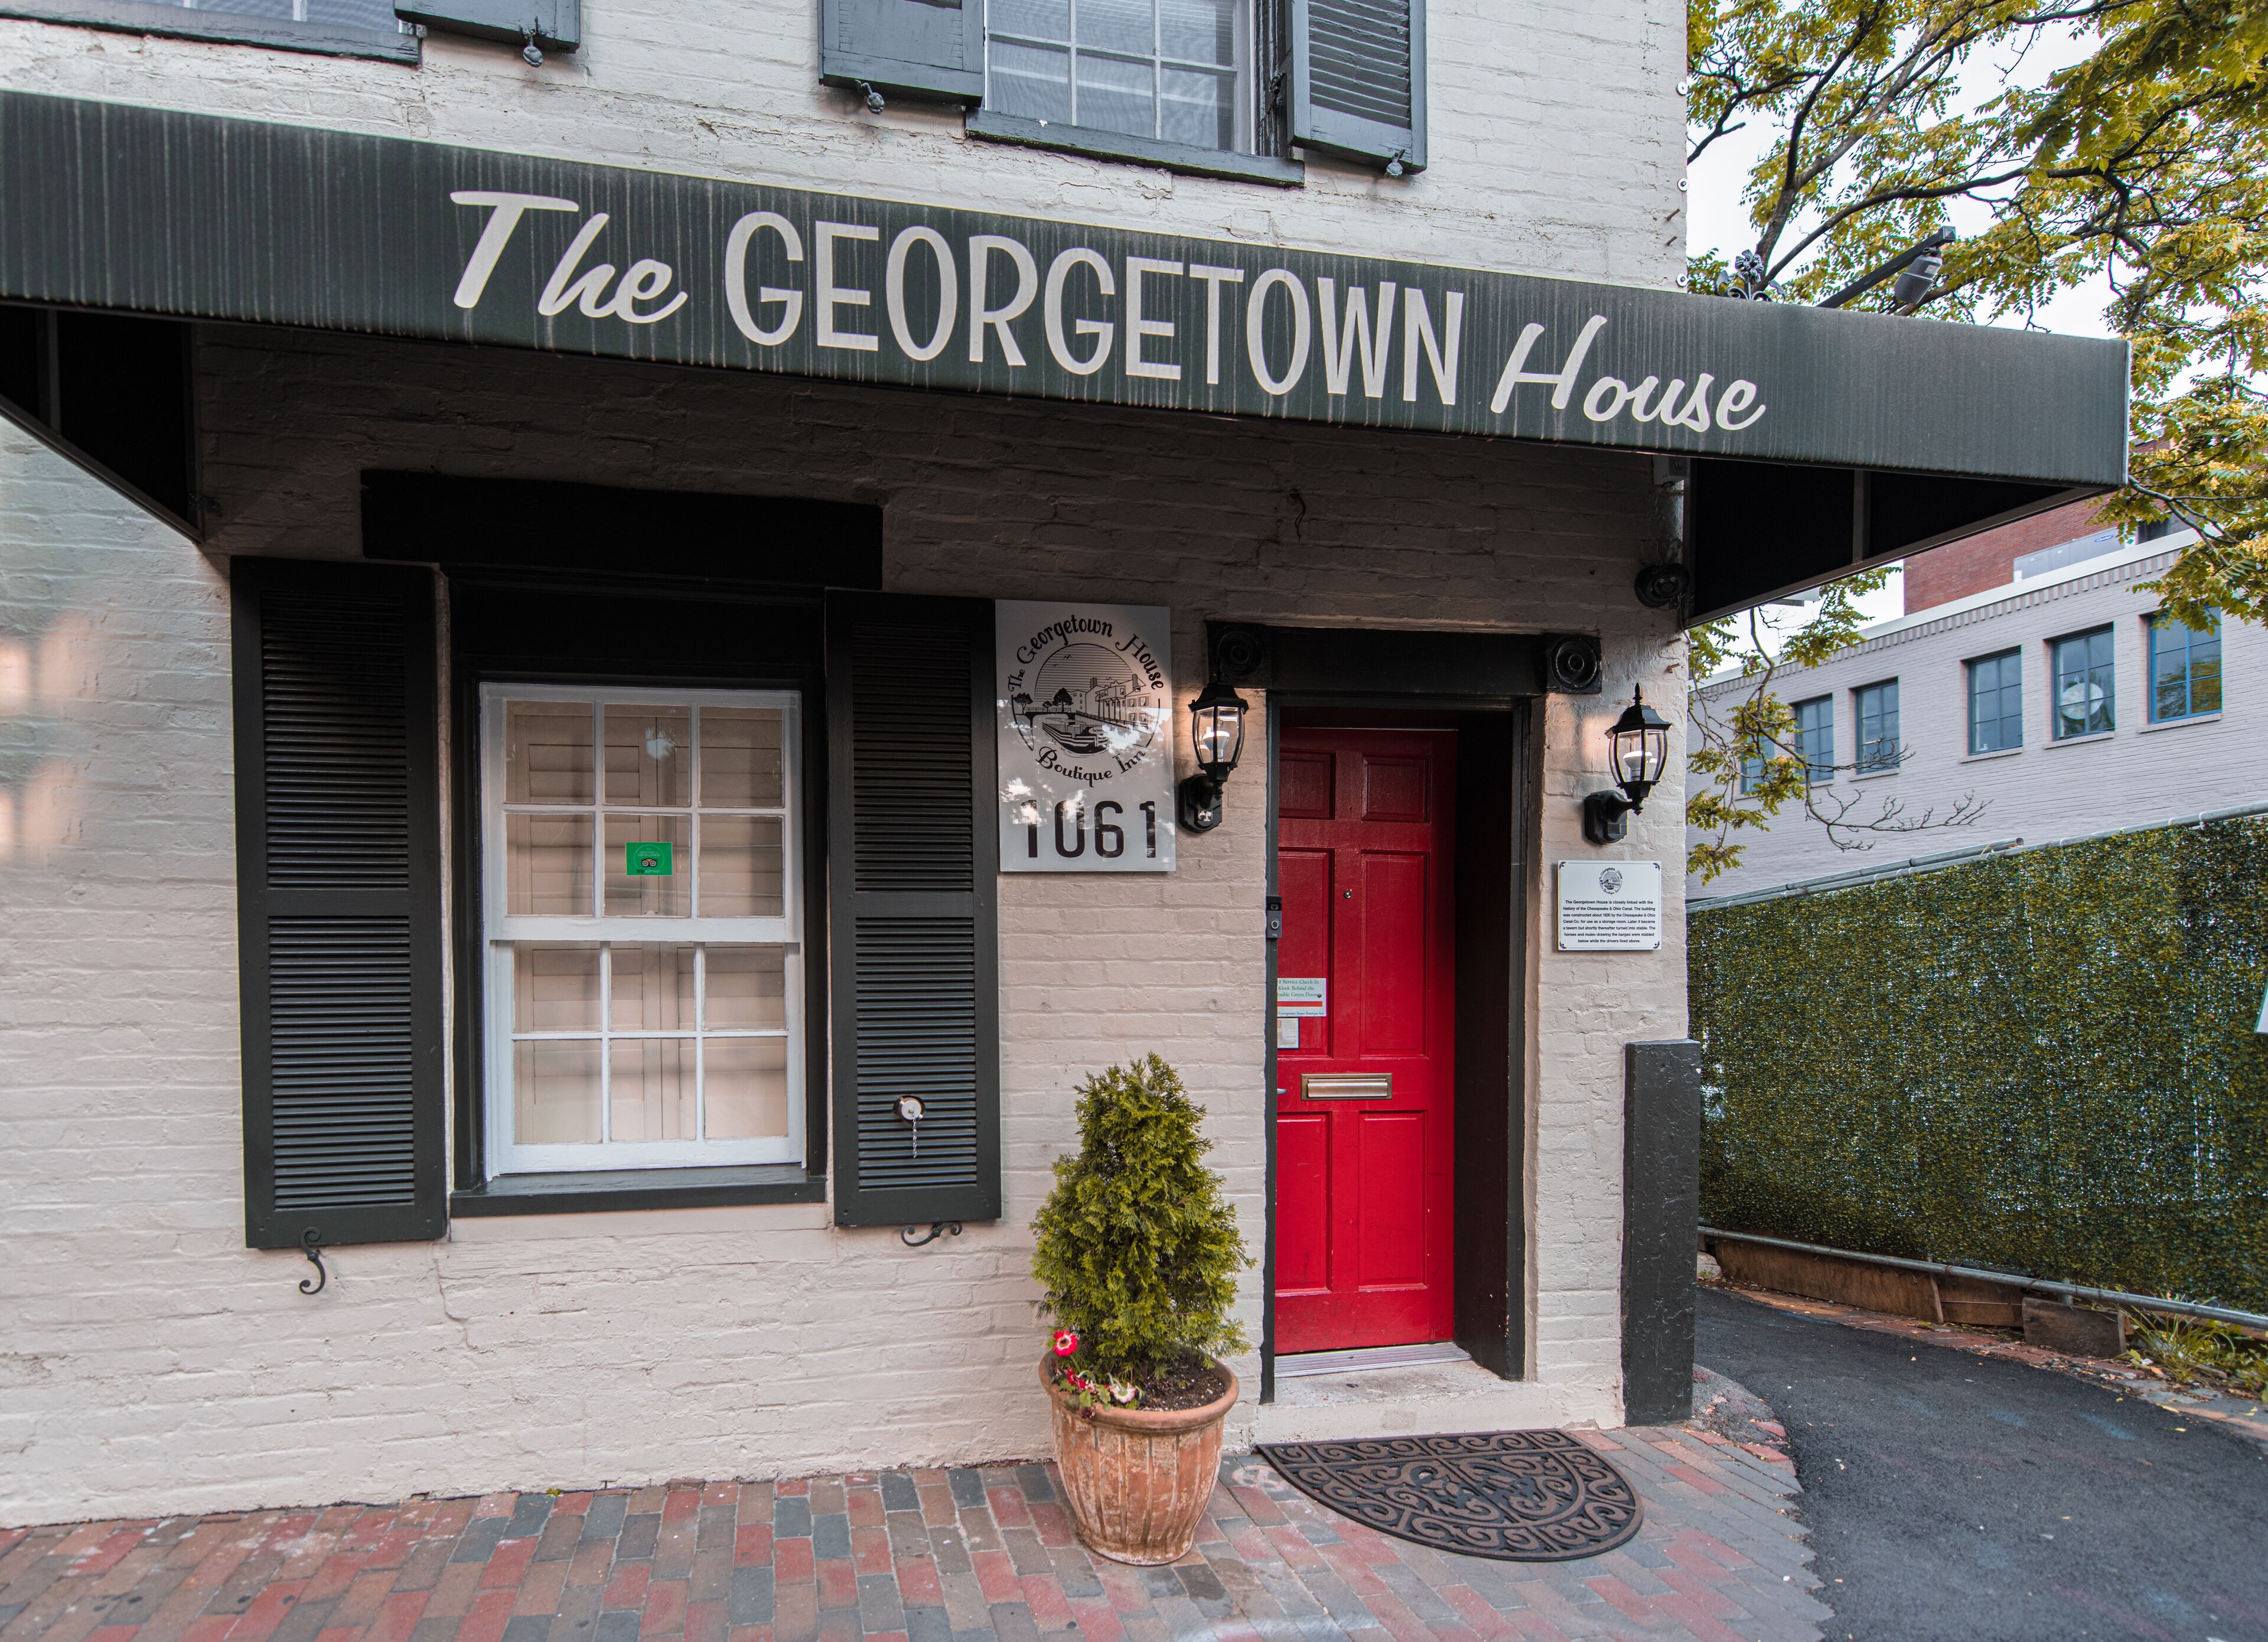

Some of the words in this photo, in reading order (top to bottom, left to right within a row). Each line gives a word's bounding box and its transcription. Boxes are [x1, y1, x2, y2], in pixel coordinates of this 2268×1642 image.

[450, 190, 687, 324] The
[725, 211, 1464, 406] GEORGETOWN
[1490, 314, 1767, 432] House
[1016, 614, 1113, 664] Georgetown
[1115, 633, 1164, 690] House
[1008, 669, 1025, 692] The
[1035, 746, 1113, 787] Boutique
[1112, 750, 1146, 774] Inn
[1020, 799, 1156, 859] 1061
